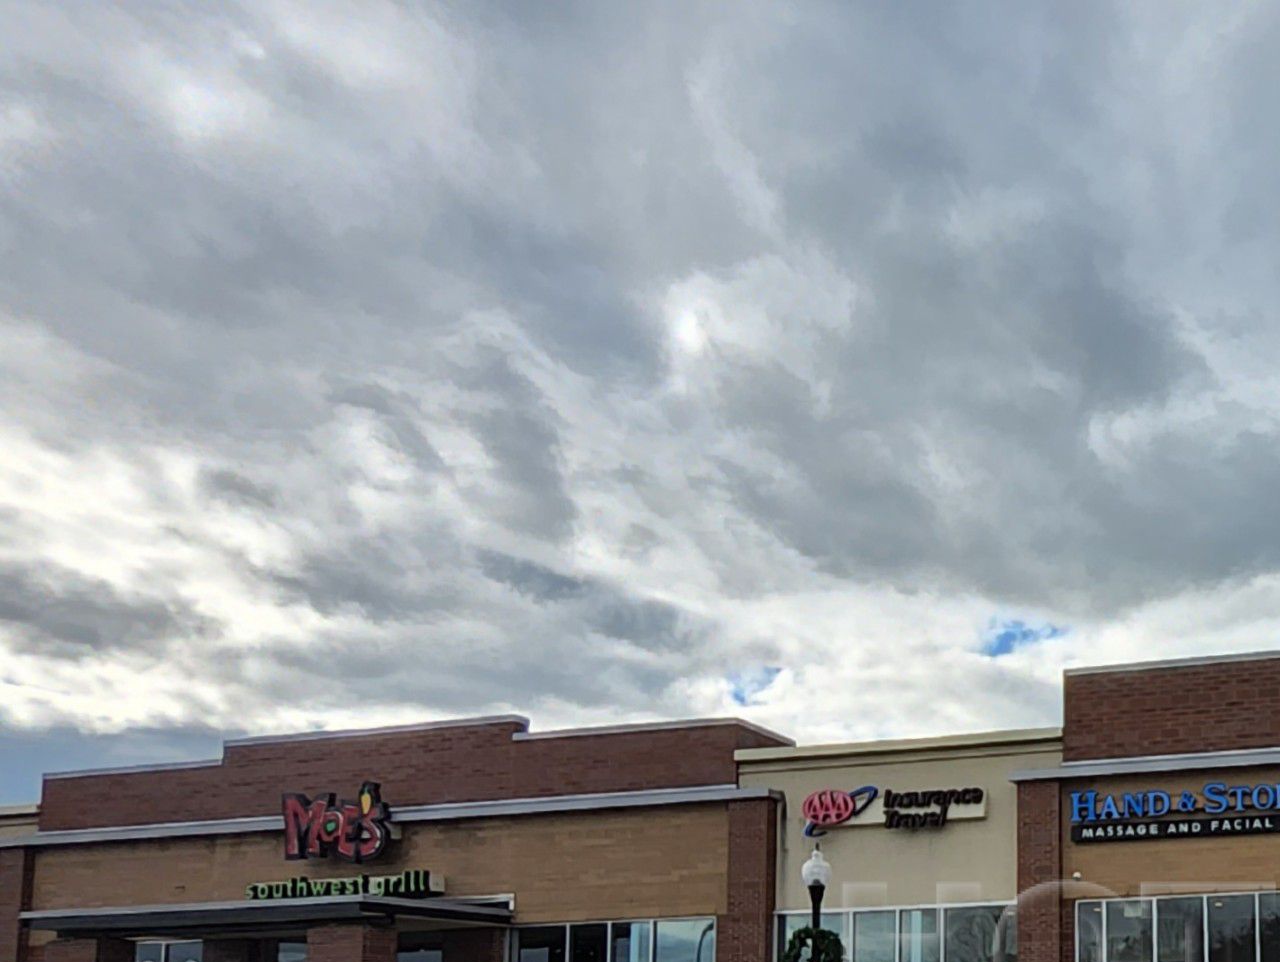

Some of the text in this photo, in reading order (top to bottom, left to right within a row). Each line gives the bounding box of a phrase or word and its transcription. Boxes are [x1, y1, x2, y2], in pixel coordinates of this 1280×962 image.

[803, 790, 854, 825] AAA
[884, 788, 983, 808] Insurance
[1071, 789, 1171, 822] HAND
[1177, 791, 1197, 812] &
[884, 807, 948, 829] Travel
[1082, 824, 1159, 838] MASSAGE
[1167, 822, 1201, 834] AND
[1211, 818, 1274, 831] FACIAL
[246, 870, 429, 898] southwest grill
